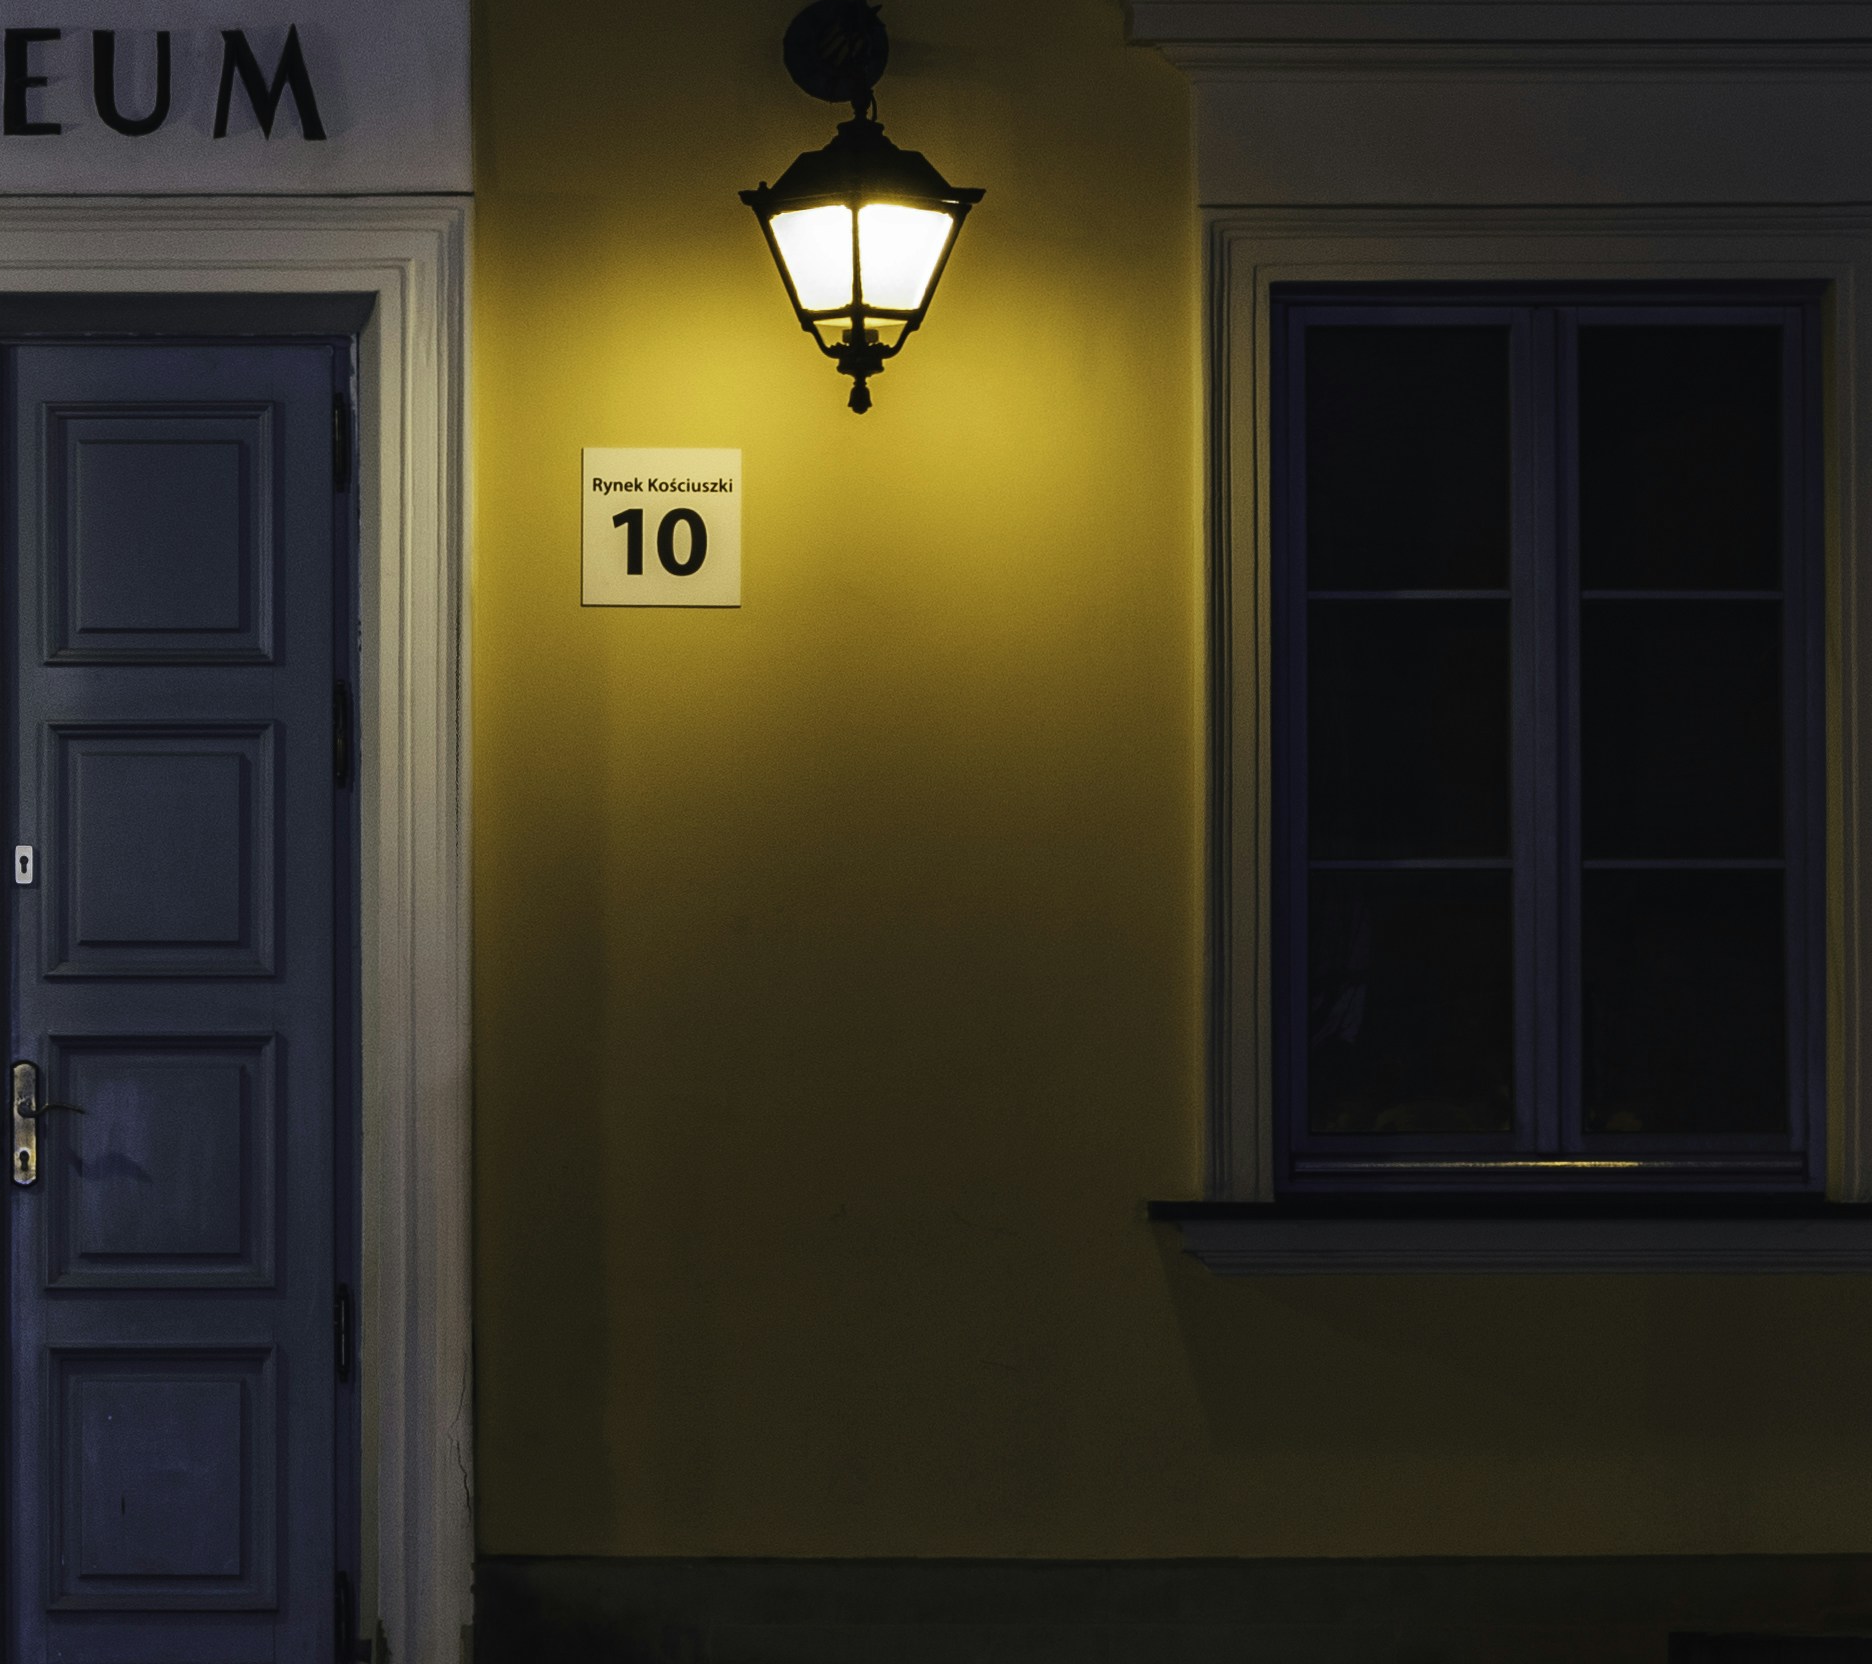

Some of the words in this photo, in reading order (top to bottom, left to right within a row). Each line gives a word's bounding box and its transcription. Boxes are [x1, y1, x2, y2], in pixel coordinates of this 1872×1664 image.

[592, 477, 643, 495] Rynek
[648, 477, 733, 493] Kościuszki
[612, 507, 707, 576] 10
